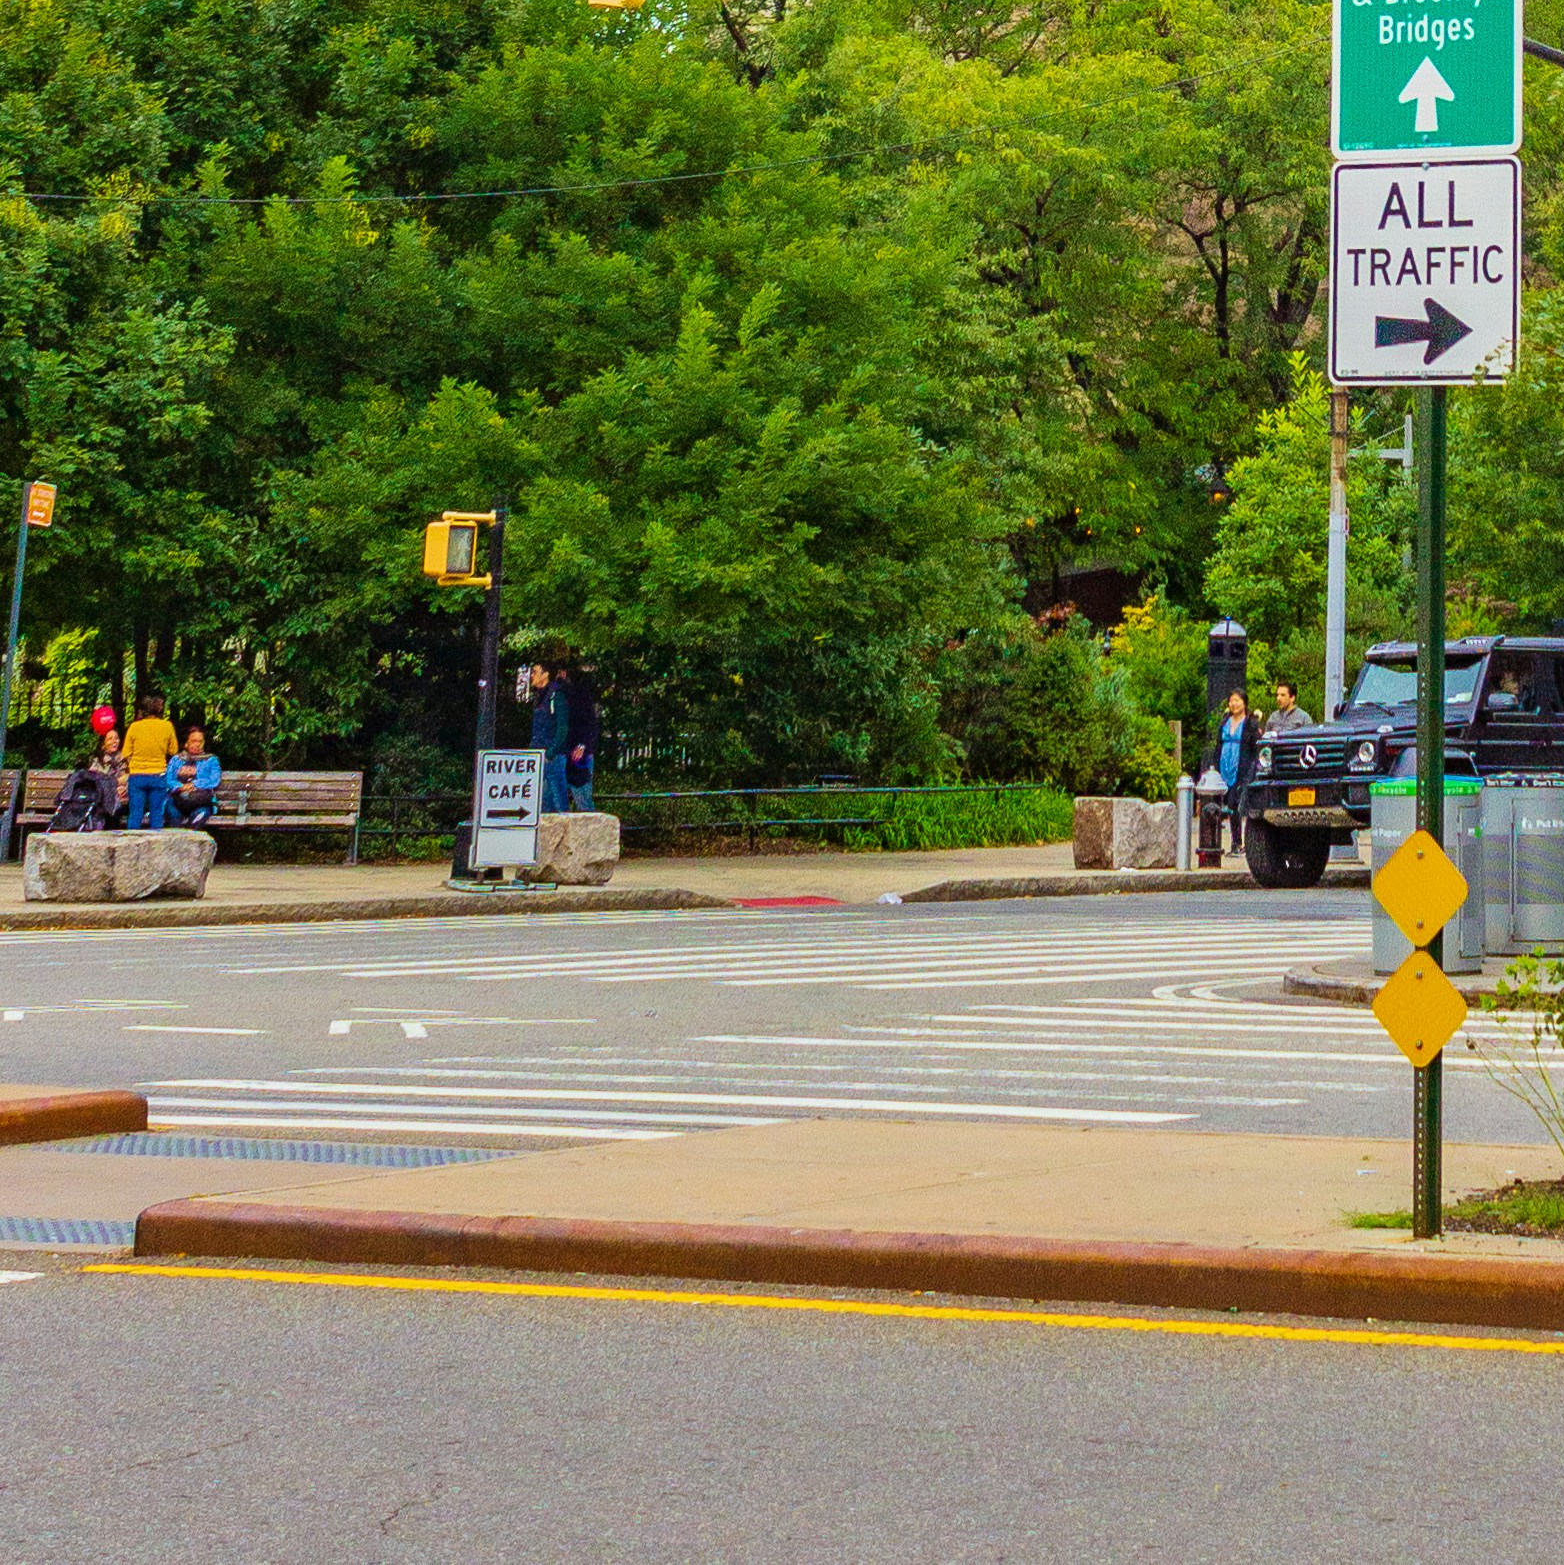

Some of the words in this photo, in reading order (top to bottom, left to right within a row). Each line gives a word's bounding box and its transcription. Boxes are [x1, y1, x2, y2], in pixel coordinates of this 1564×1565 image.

[1379, 13, 1475, 51] Bridges
[1378, 180, 1474, 230] ALL
[1347, 245, 1504, 286] TRAFFIC
[486, 760, 536, 774] RIVER
[488, 778, 532, 799] CAFÉ
